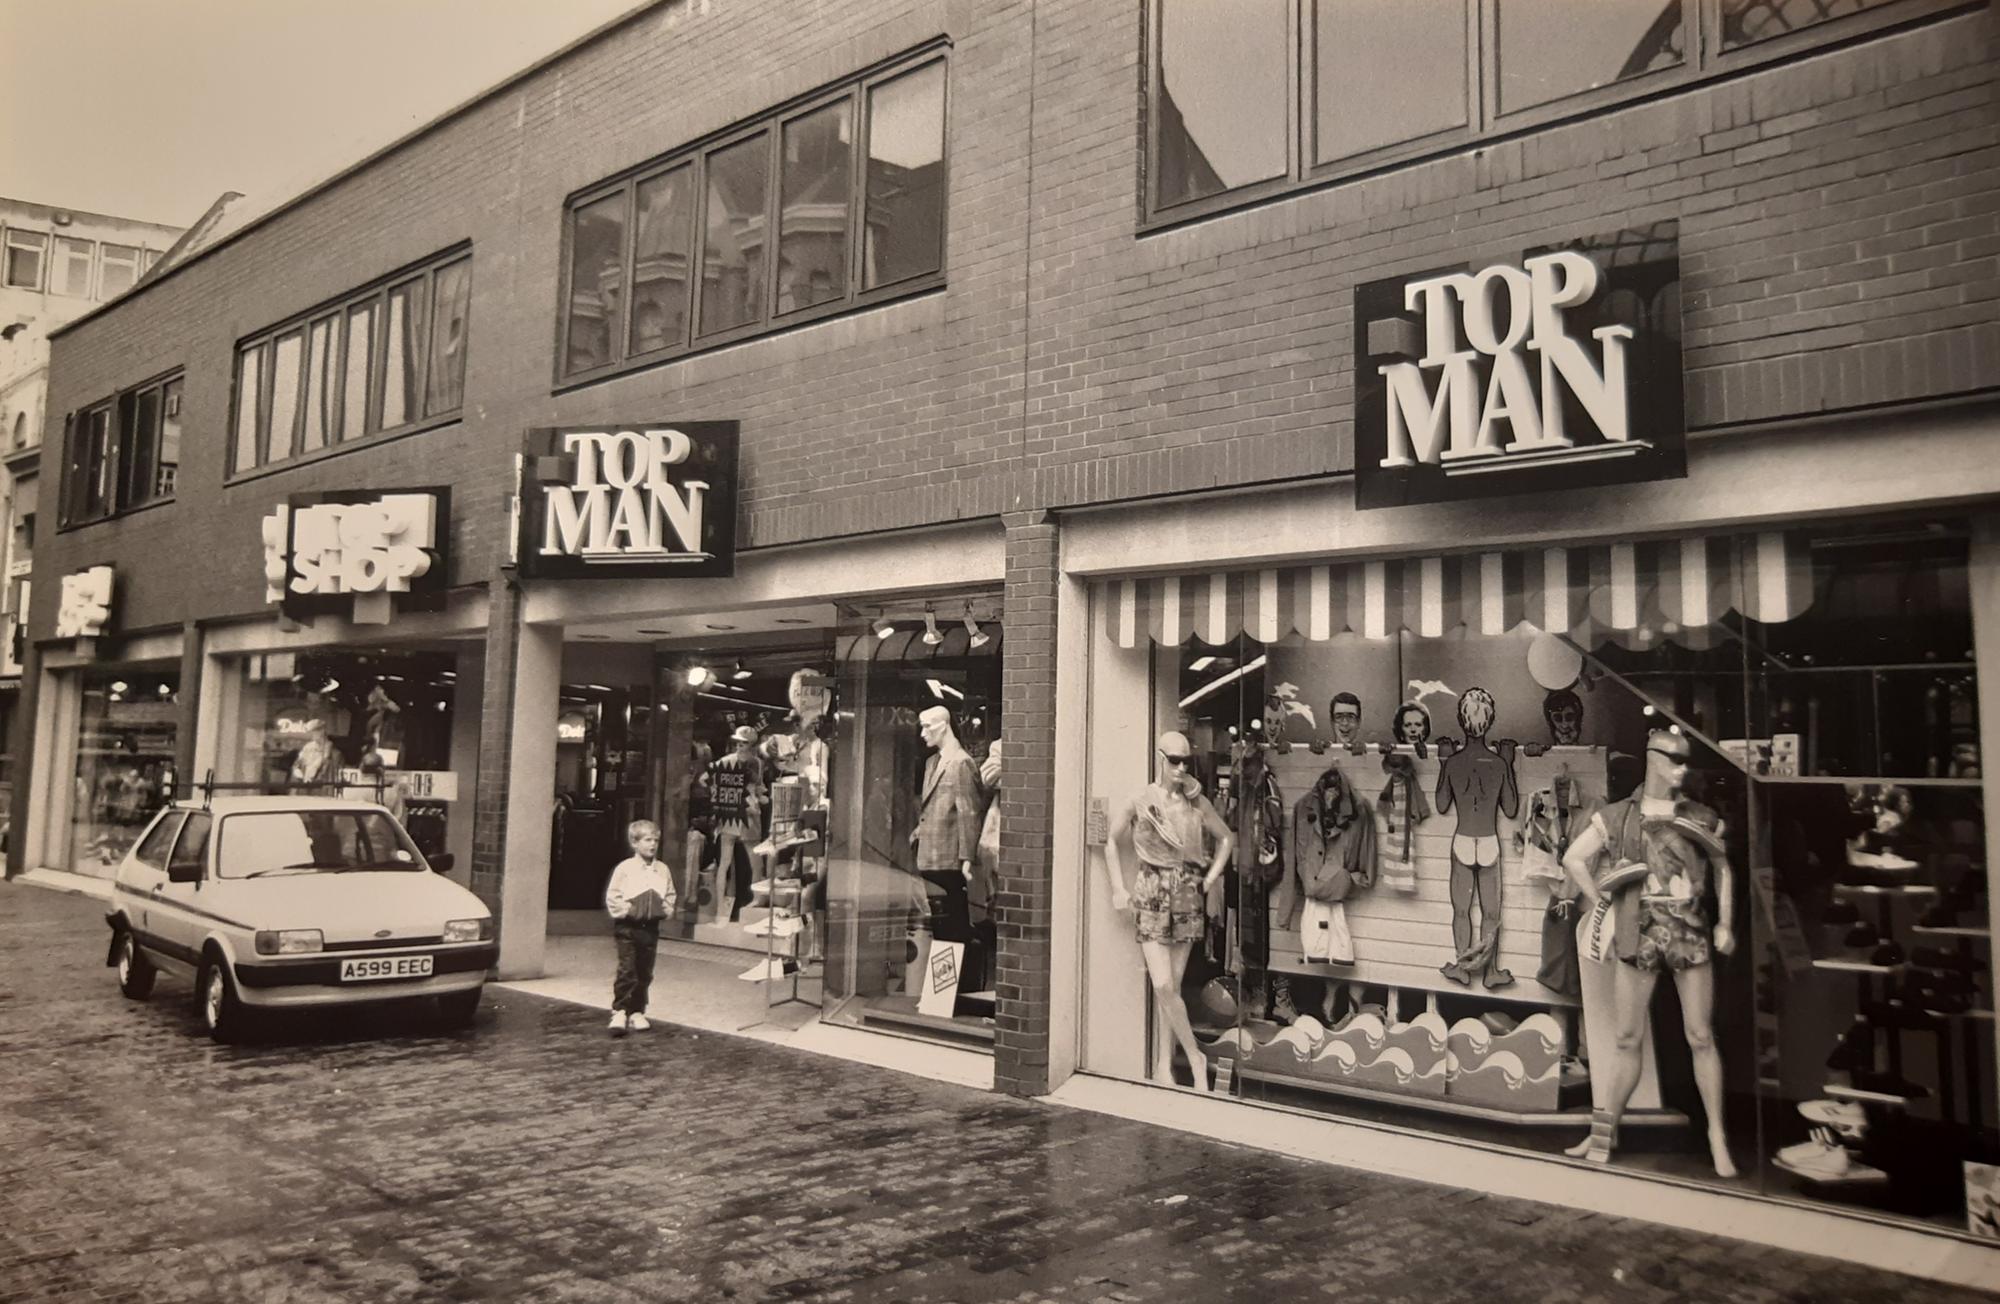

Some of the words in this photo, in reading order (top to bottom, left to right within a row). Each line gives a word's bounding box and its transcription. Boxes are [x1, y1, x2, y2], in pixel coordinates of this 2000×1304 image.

[1405, 251, 1597, 368] TOP
[1378, 324, 1634, 467] MAN
[565, 429, 691, 492] TOP
[540, 480, 710, 555] MAN
[290, 544, 427, 594] SHOP
[719, 787, 743, 804] EVENT
[720, 773, 744, 787] PRICE
[344, 961, 392, 977] A599
[397, 959, 431, 974] EEC
